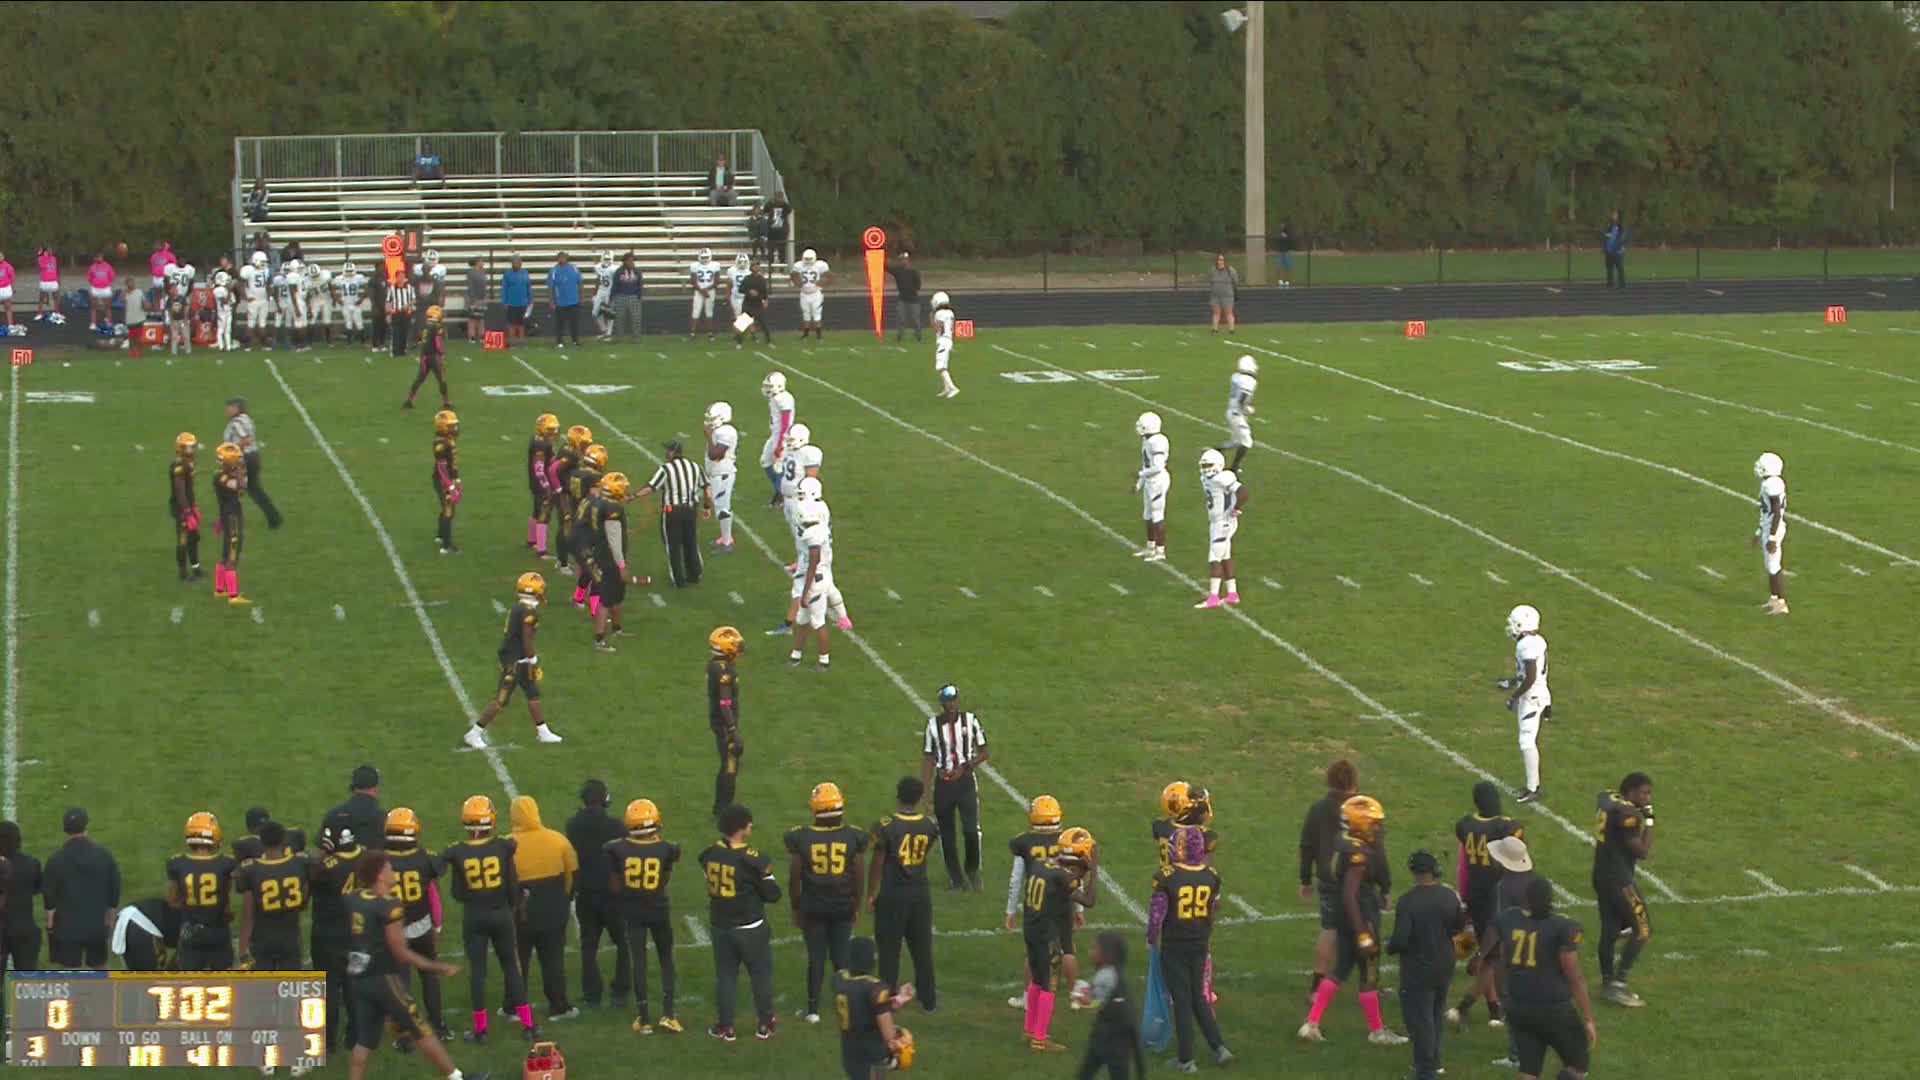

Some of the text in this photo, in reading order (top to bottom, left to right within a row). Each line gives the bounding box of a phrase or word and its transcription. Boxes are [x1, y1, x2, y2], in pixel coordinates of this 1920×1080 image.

[172, 273, 188, 287] 50
[15, 350, 32, 365] 50
[811, 842, 848, 875] 55
[898, 832, 929, 865] 40
[1465, 831, 1490, 866] 44
[185, 872, 217, 906] 12
[463, 855, 501, 890] 22
[624, 857, 661, 890] 28
[706, 861, 736, 897] 55
[261, 876, 302, 911] 23
[1177, 885, 1212, 920] 29
[1511, 928, 1538, 968] 71
